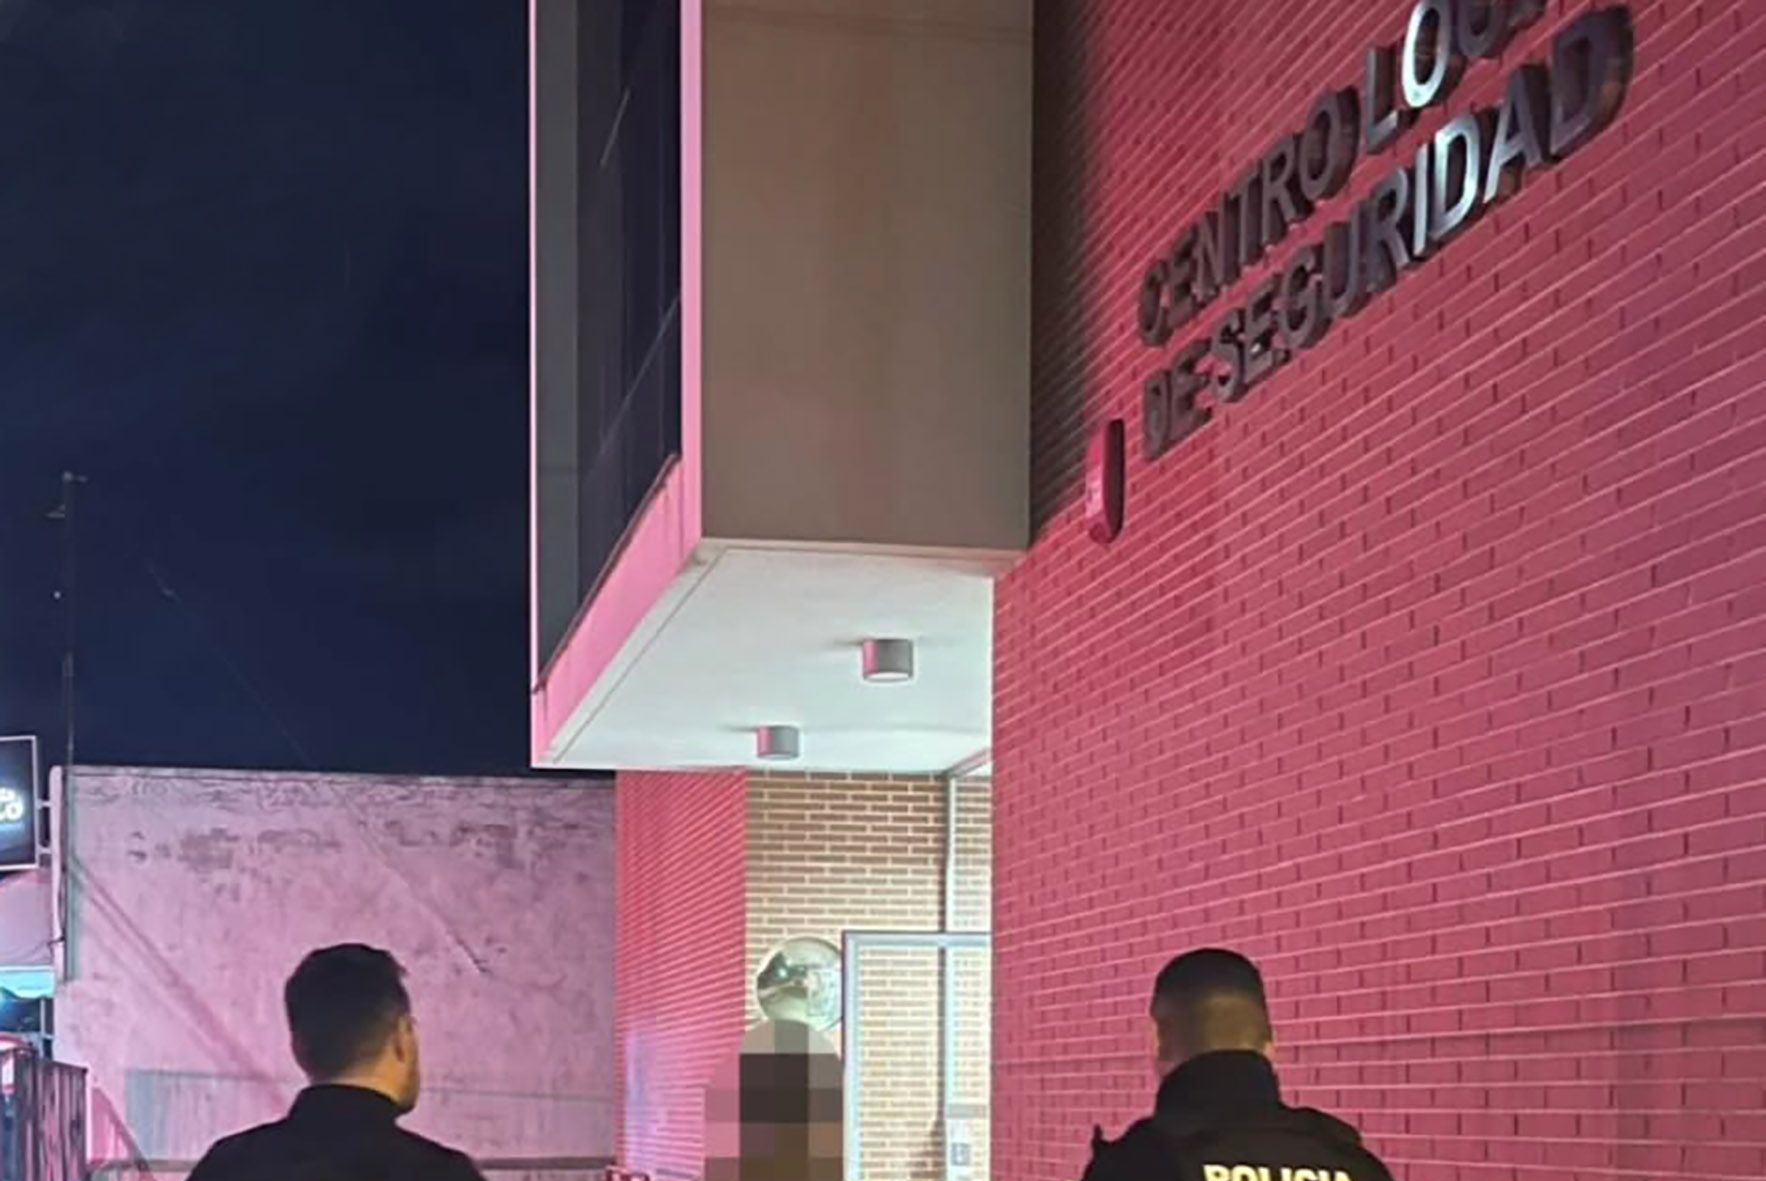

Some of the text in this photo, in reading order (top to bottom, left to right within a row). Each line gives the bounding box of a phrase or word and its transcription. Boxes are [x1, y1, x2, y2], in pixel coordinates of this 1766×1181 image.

[1137, 86, 1360, 347] CENTRO
[1143, 5, 1634, 462] DE SEGURIDAD
